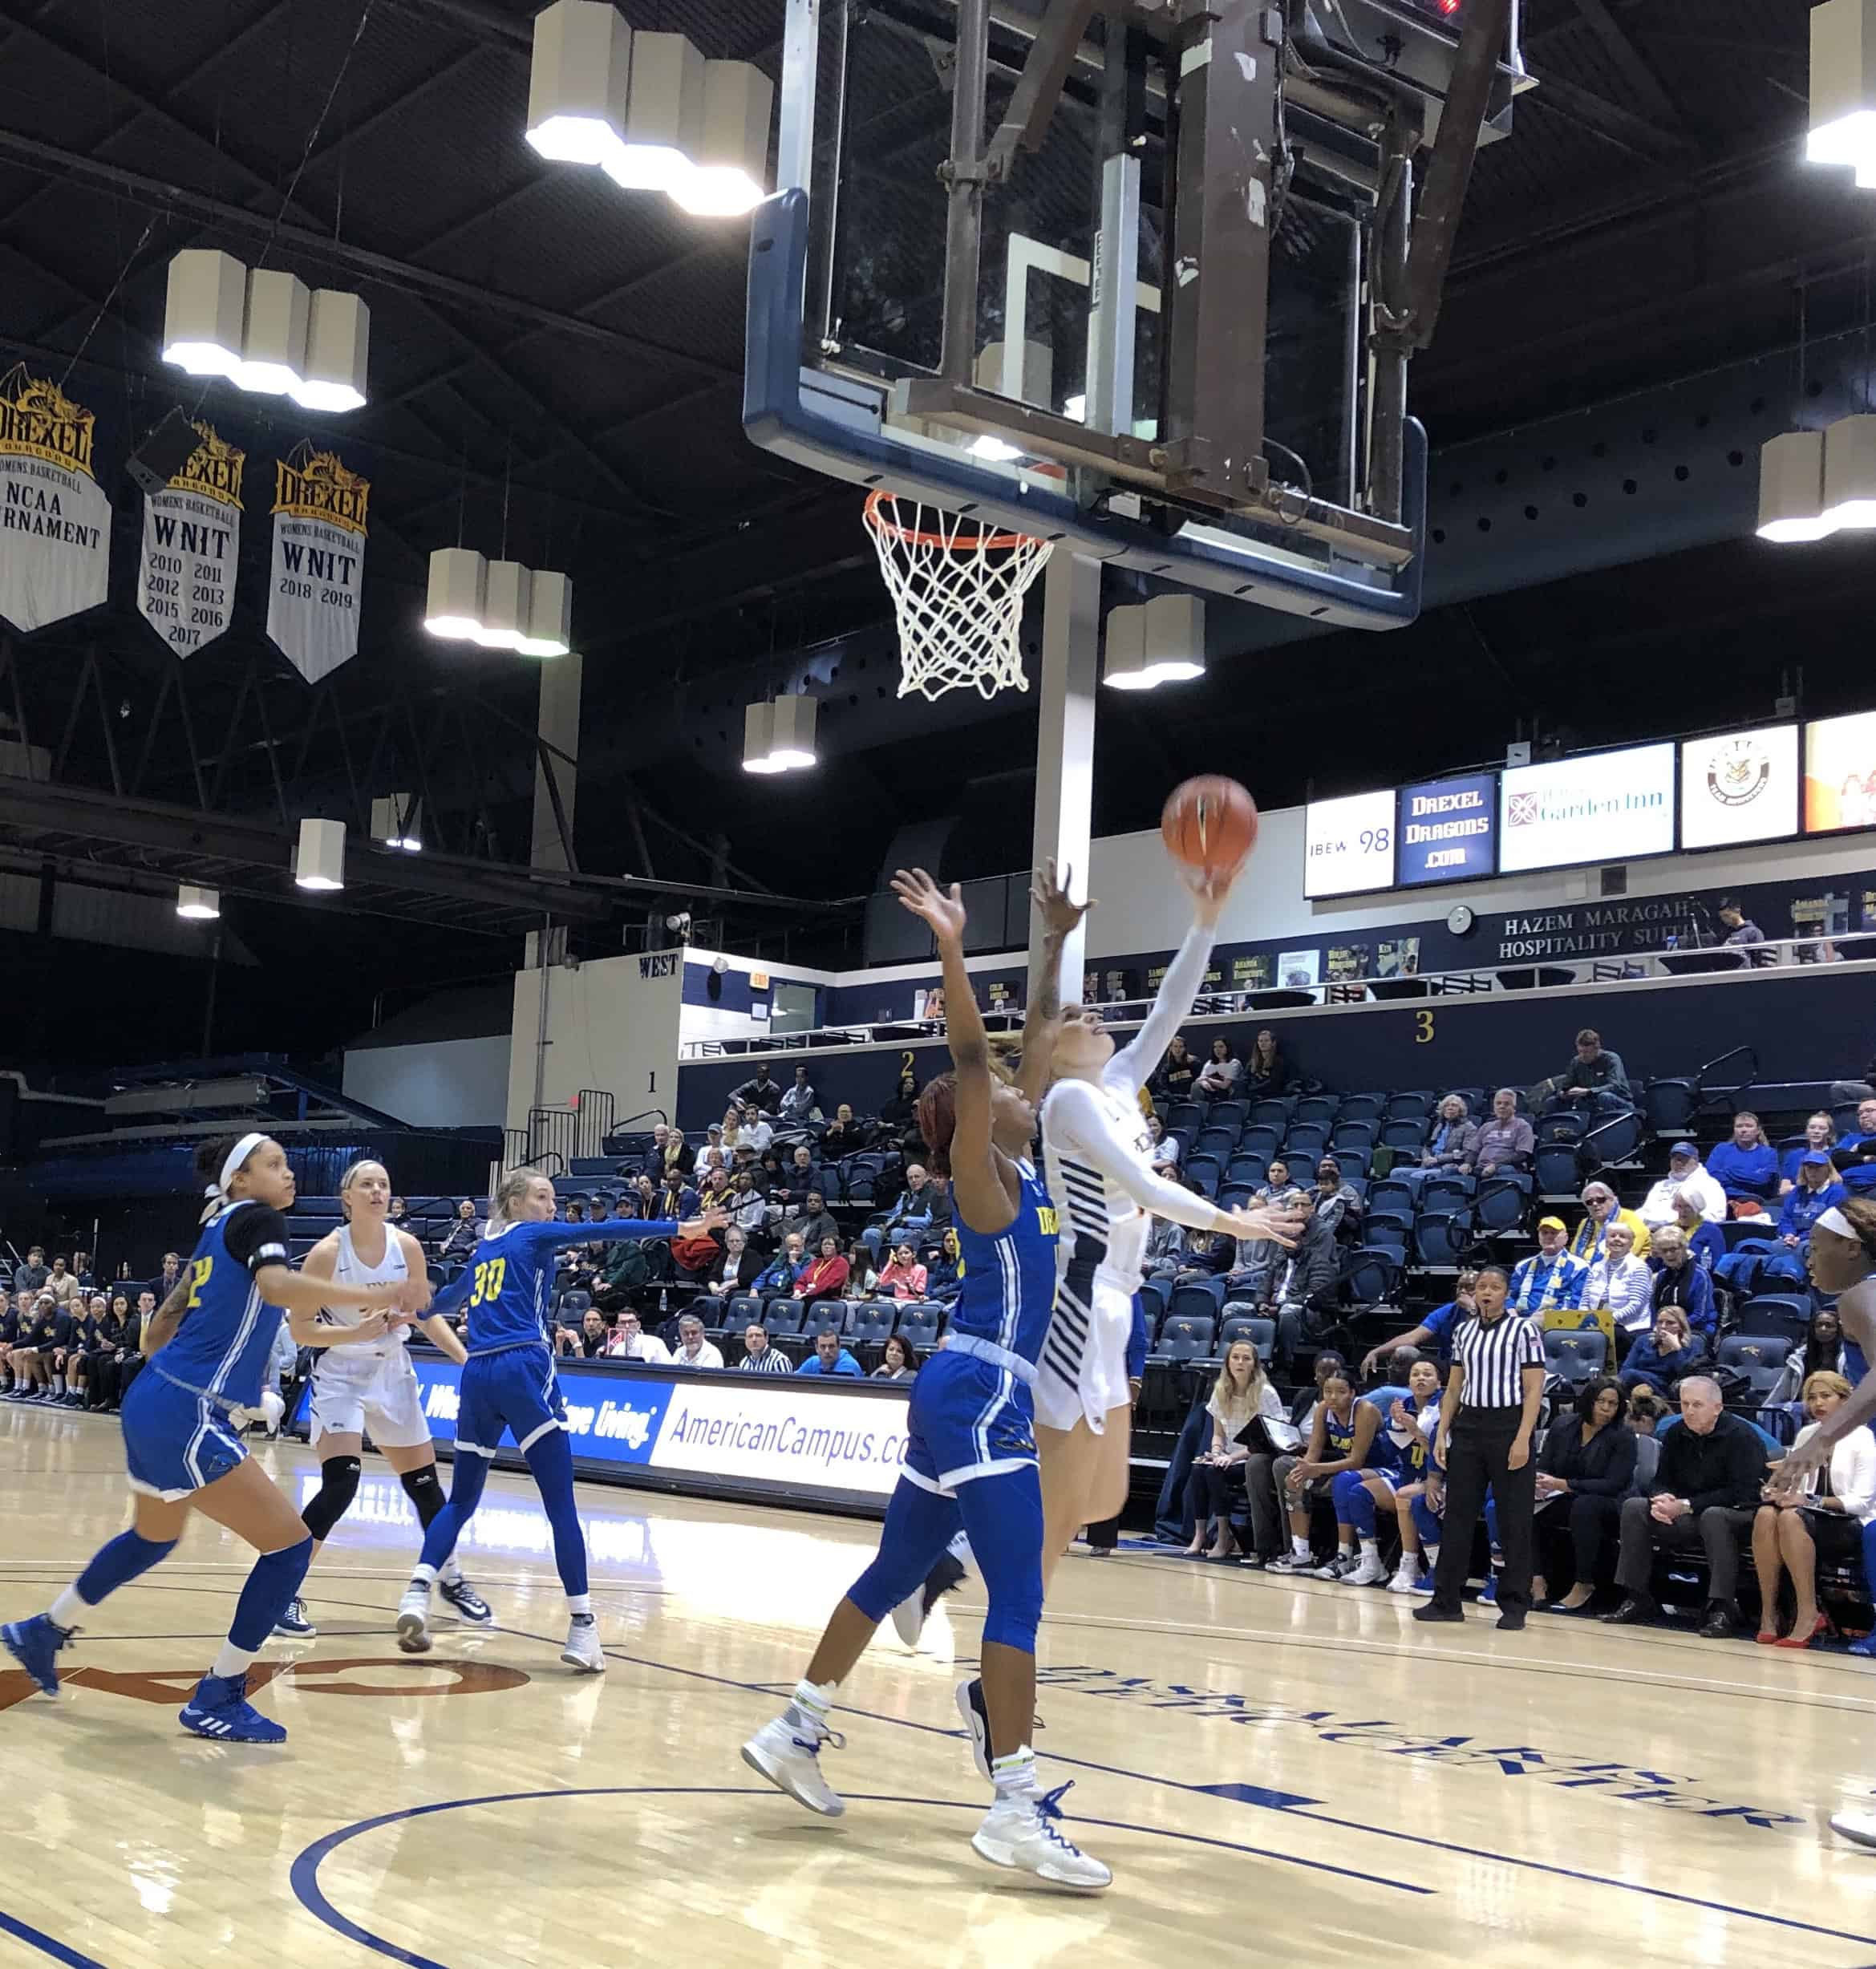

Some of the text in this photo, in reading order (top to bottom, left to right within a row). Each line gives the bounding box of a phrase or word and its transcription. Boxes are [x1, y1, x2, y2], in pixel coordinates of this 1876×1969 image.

[0, 460, 82, 494] OMENS BASKETBALL
[182, 456, 239, 496] EXEL
[6, 481, 62, 515] NCAA
[152, 494, 234, 526] WOMENS BASKETBALL
[278, 463, 367, 526] DREXEL
[0, 506, 99, 549] RNAMENT
[153, 513, 231, 560] WNIT
[281, 523, 360, 554] WOMENS BASKETBALL
[149, 553, 222, 583] 2010 2011
[282, 541, 356, 585] WNIT
[148, 575, 225, 606] 2012 2013
[280, 577, 352, 609] 2018 2019
[146, 597, 223, 627] 2015 2016
[168, 626, 201, 646] 2017
[1541, 792, 1663, 821] Garden Inn
[1310, 828, 1390, 857] IBEW 98
[1505, 914, 1573, 936] HAZEM
[1499, 930, 1623, 958] HOSPITALITY
[639, 954, 679, 978] WEST
[1415, 1010, 1435, 1043] 3
[901, 1051, 914, 1078] 2
[648, 1072, 656, 1093] 1
[470, 1258, 506, 1307] 30
[669, 1408, 912, 1467] AmericanCampus.co
[1318, 1732, 1807, 1829] CENTER
